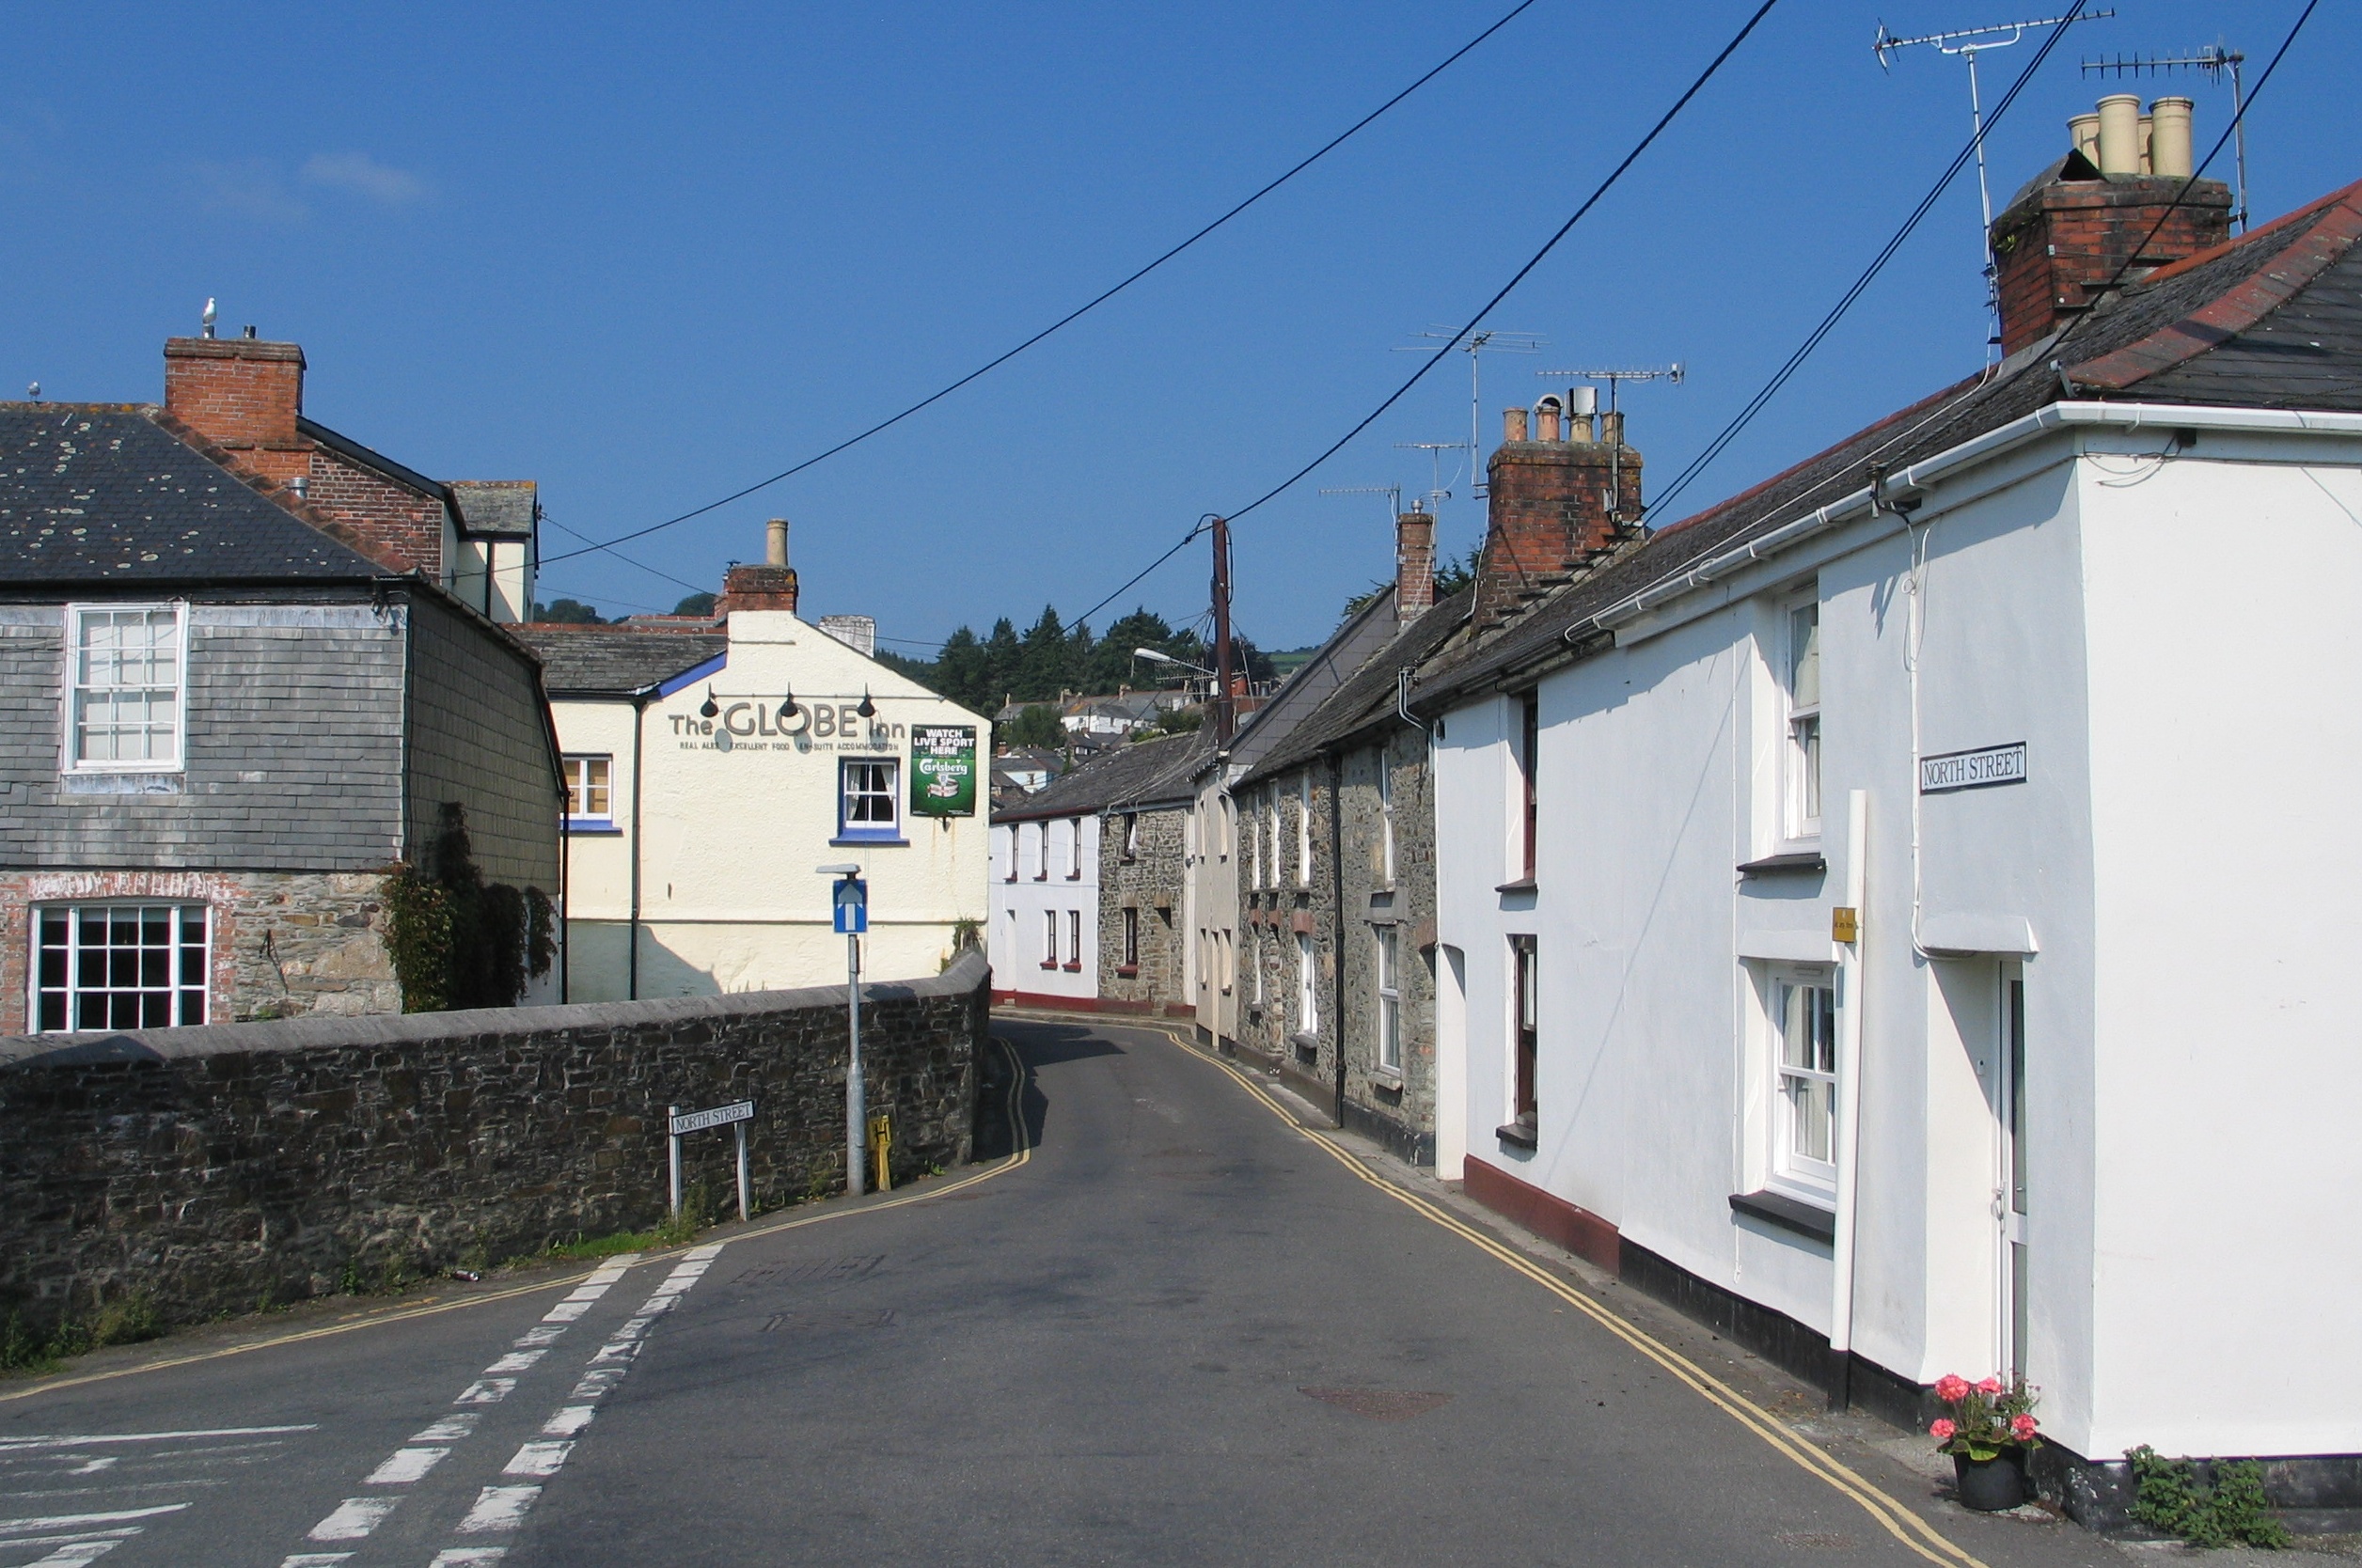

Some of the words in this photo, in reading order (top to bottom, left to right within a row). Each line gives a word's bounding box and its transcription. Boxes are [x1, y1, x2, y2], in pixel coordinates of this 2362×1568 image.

[668, 714, 713, 735] The
[724, 702, 858, 737] GLOBE
[869, 717, 905, 738] Inn
[914, 738, 937, 746] LIVE
[940, 738, 974, 746] SPORT
[925, 729, 963, 738] WATCH
[772, 743, 790, 751] FOOD
[930, 746, 958, 755] HERE
[919, 758, 968, 776] Carlsberg
[1924, 760, 1965, 786] NORTH
[1968, 750, 2023, 780] STREET
[676, 1113, 711, 1132] NORTH
[712, 1105, 751, 1122] STREET
[874, 1122, 888, 1143] H
